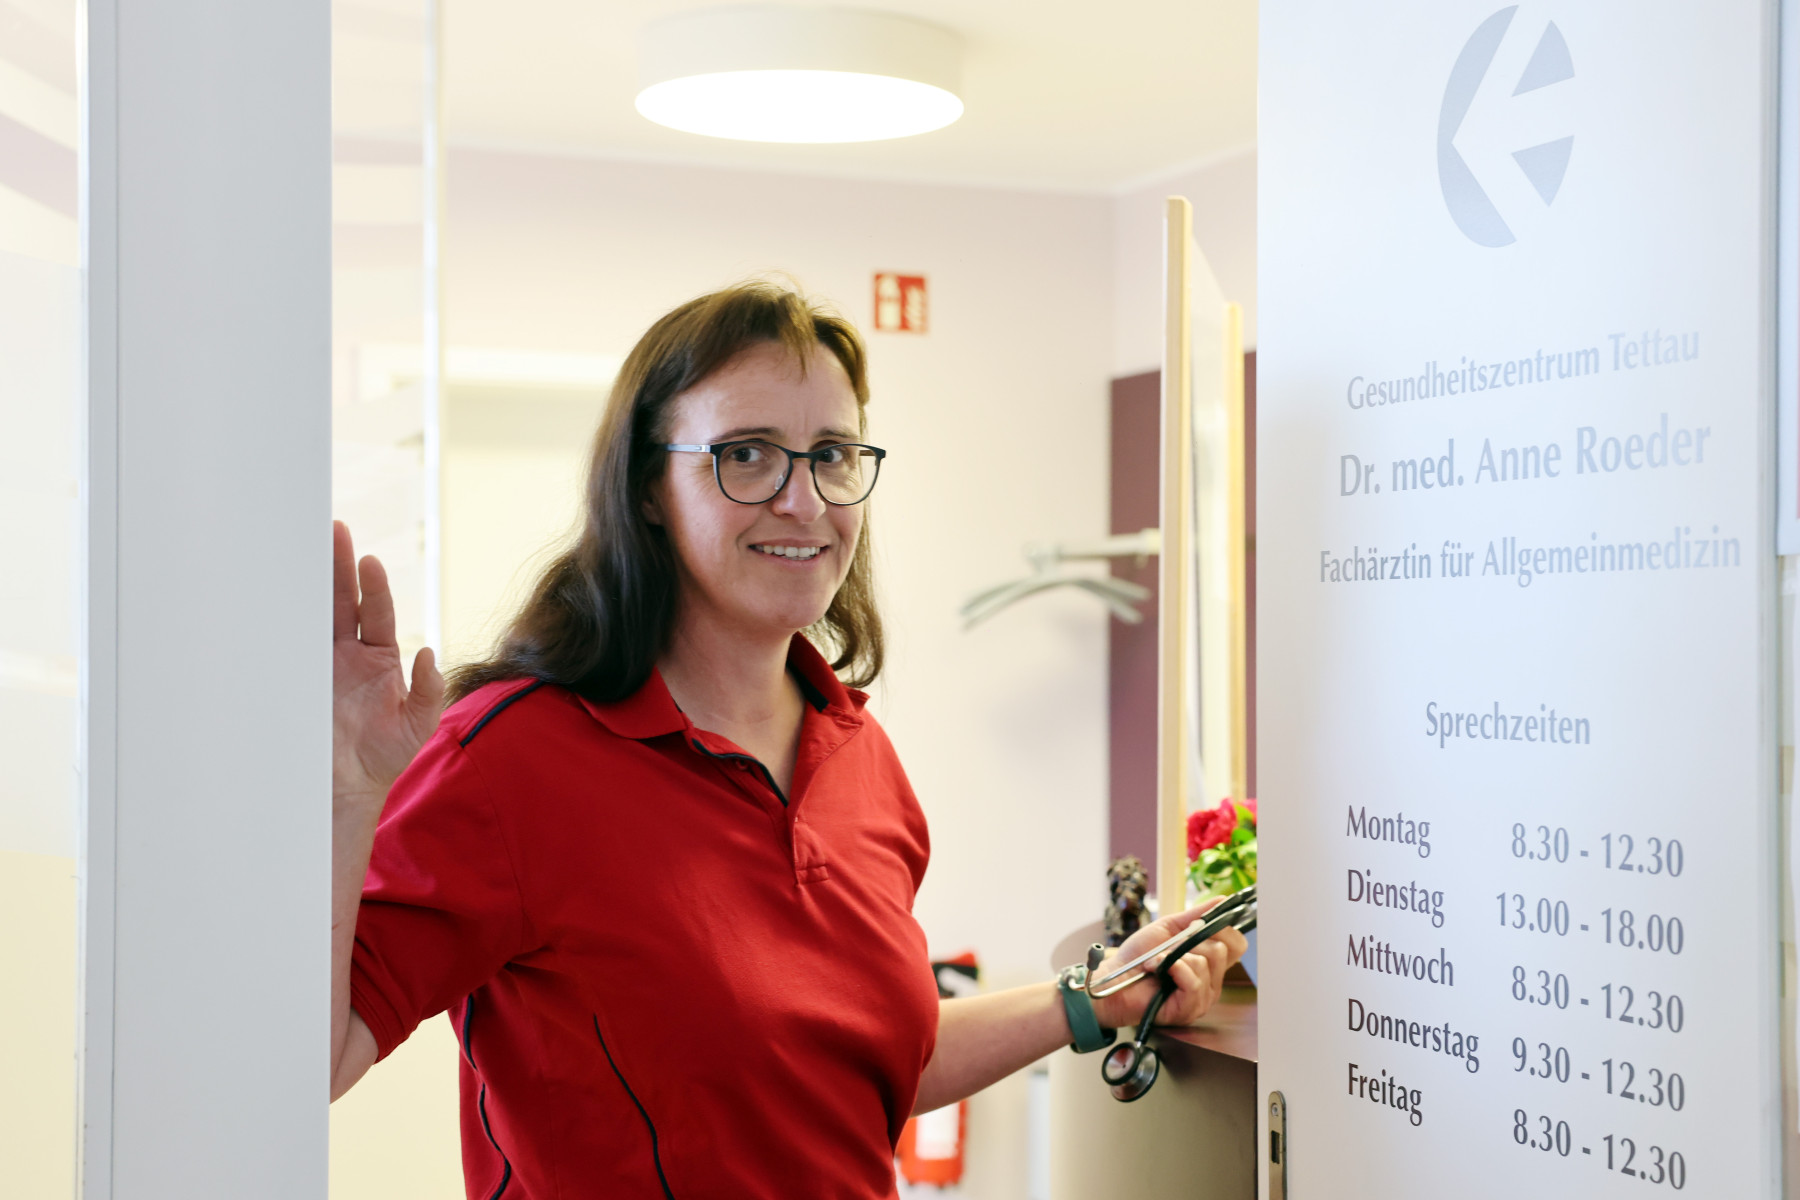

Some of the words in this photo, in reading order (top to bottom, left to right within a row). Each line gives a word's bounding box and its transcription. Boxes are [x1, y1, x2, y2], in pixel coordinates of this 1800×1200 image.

[1346, 344, 1600, 410] Gesundheitszentrum
[1608, 328, 1700, 371] Tettau
[1339, 454, 1381, 497] Dr.
[1392, 439, 1464, 491] med.
[1476, 437, 1561, 484] Anne
[1576, 412, 1711, 475] Roeder
[1320, 543, 1431, 583] Fachärztin
[1441, 540, 1474, 577] für
[1482, 525, 1741, 589] Allgemeinmedizin
[1425, 702, 1590, 748] Sprechzeiten
[1346, 804, 1431, 858] Montag
[1511, 822, 1569, 863] 8.30
[1601, 832, 1683, 877] 12.30
[1347, 869, 1445, 928] Dienstag
[1496, 891, 1570, 937] 13.00
[1601, 907, 1684, 955] 18.00
[1346, 934, 1454, 987] Mittwoch
[1511, 965, 1570, 1009] 8.30
[1601, 982, 1684, 1033] 12.30
[1347, 998, 1480, 1073] Donnerstag
[1512, 1037, 1571, 1083] 9.30
[1602, 1058, 1684, 1112] 12.30
[1347, 1062, 1423, 1126] Freitag
[1513, 1108, 1571, 1158] 8.30
[1603, 1134, 1686, 1190] 12.30
